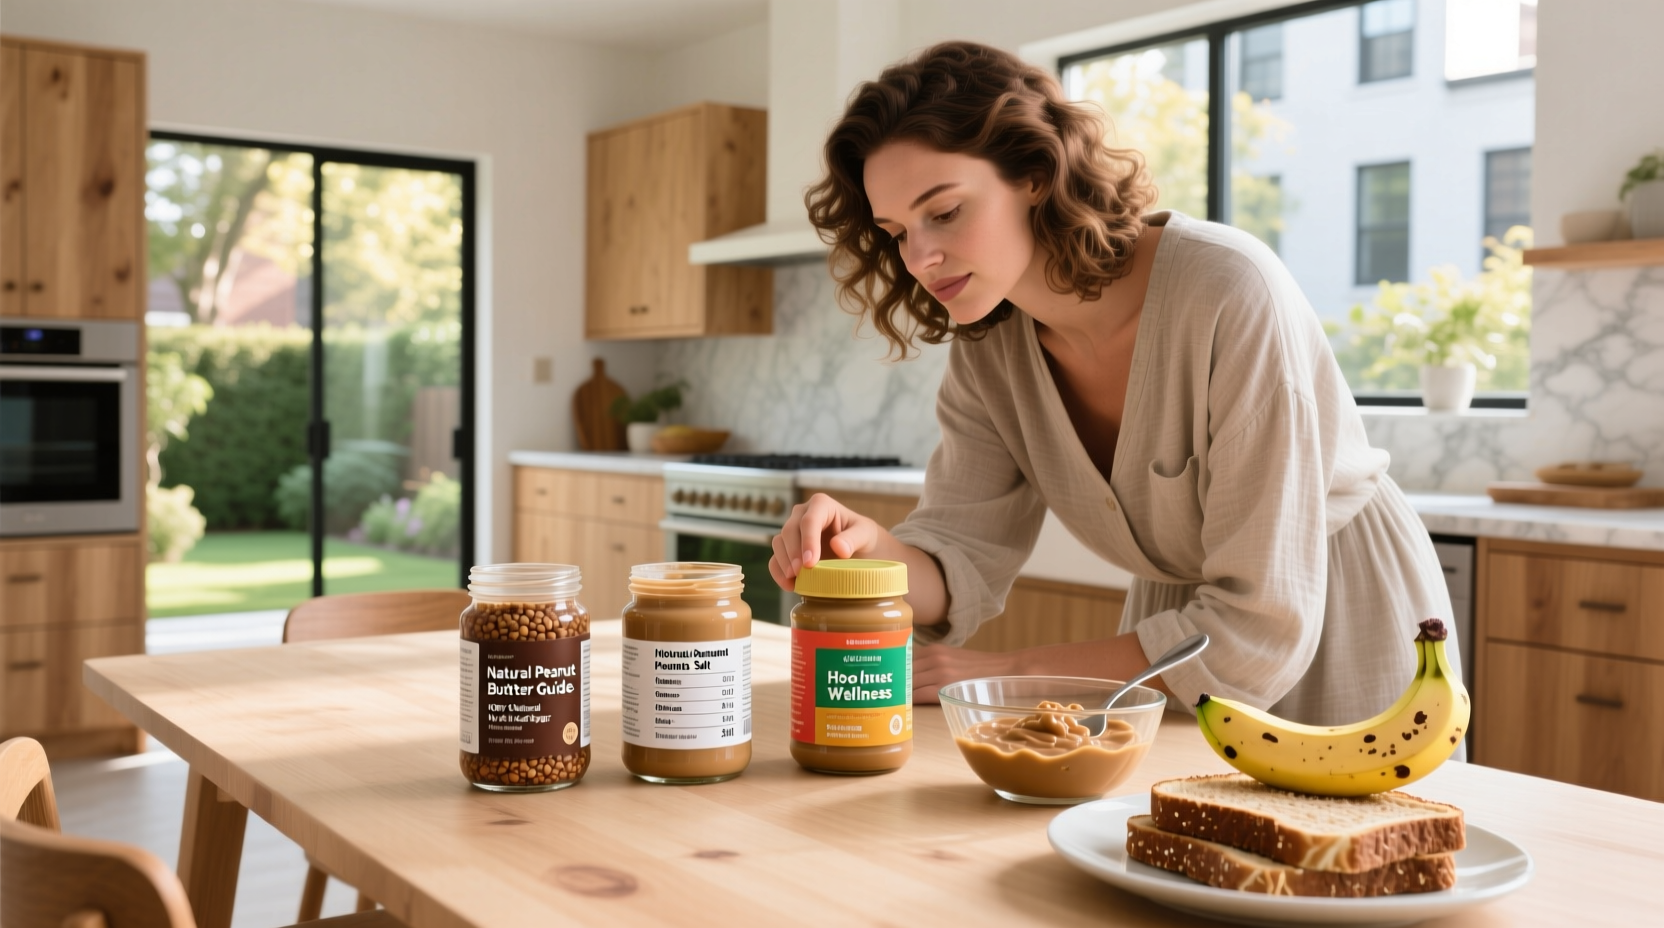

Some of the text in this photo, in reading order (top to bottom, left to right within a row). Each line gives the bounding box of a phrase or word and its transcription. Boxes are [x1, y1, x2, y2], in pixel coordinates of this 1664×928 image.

[487, 664, 576, 679] Natural Peanut
[487, 679, 575, 696] Butter Guide
[827, 686, 893, 701] Wellness
